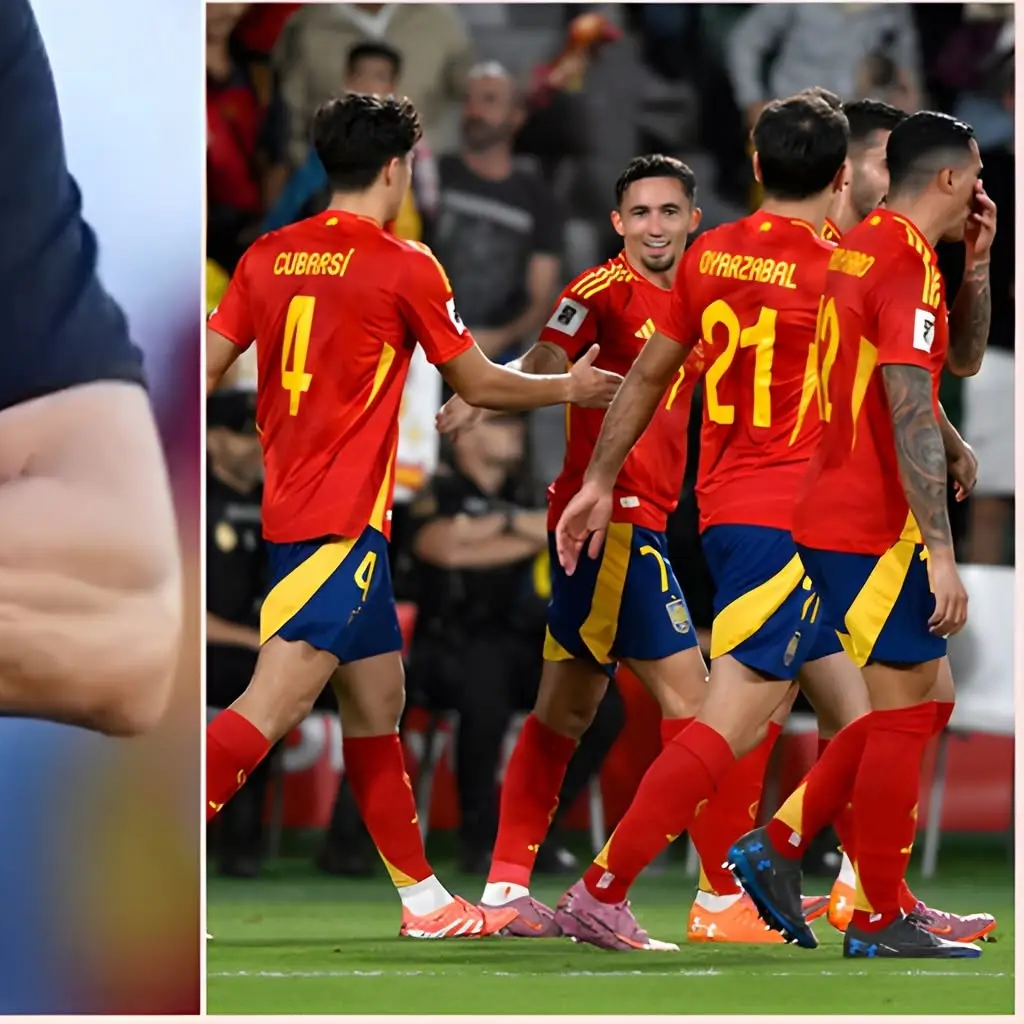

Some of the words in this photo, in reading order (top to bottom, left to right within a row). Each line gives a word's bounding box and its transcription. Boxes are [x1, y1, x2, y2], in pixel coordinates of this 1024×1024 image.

[699, 250, 797, 289] OYARZABAL
[281, 295, 316, 416] 4
[701, 299, 777, 428] 21
[639, 545, 669, 593] 7
